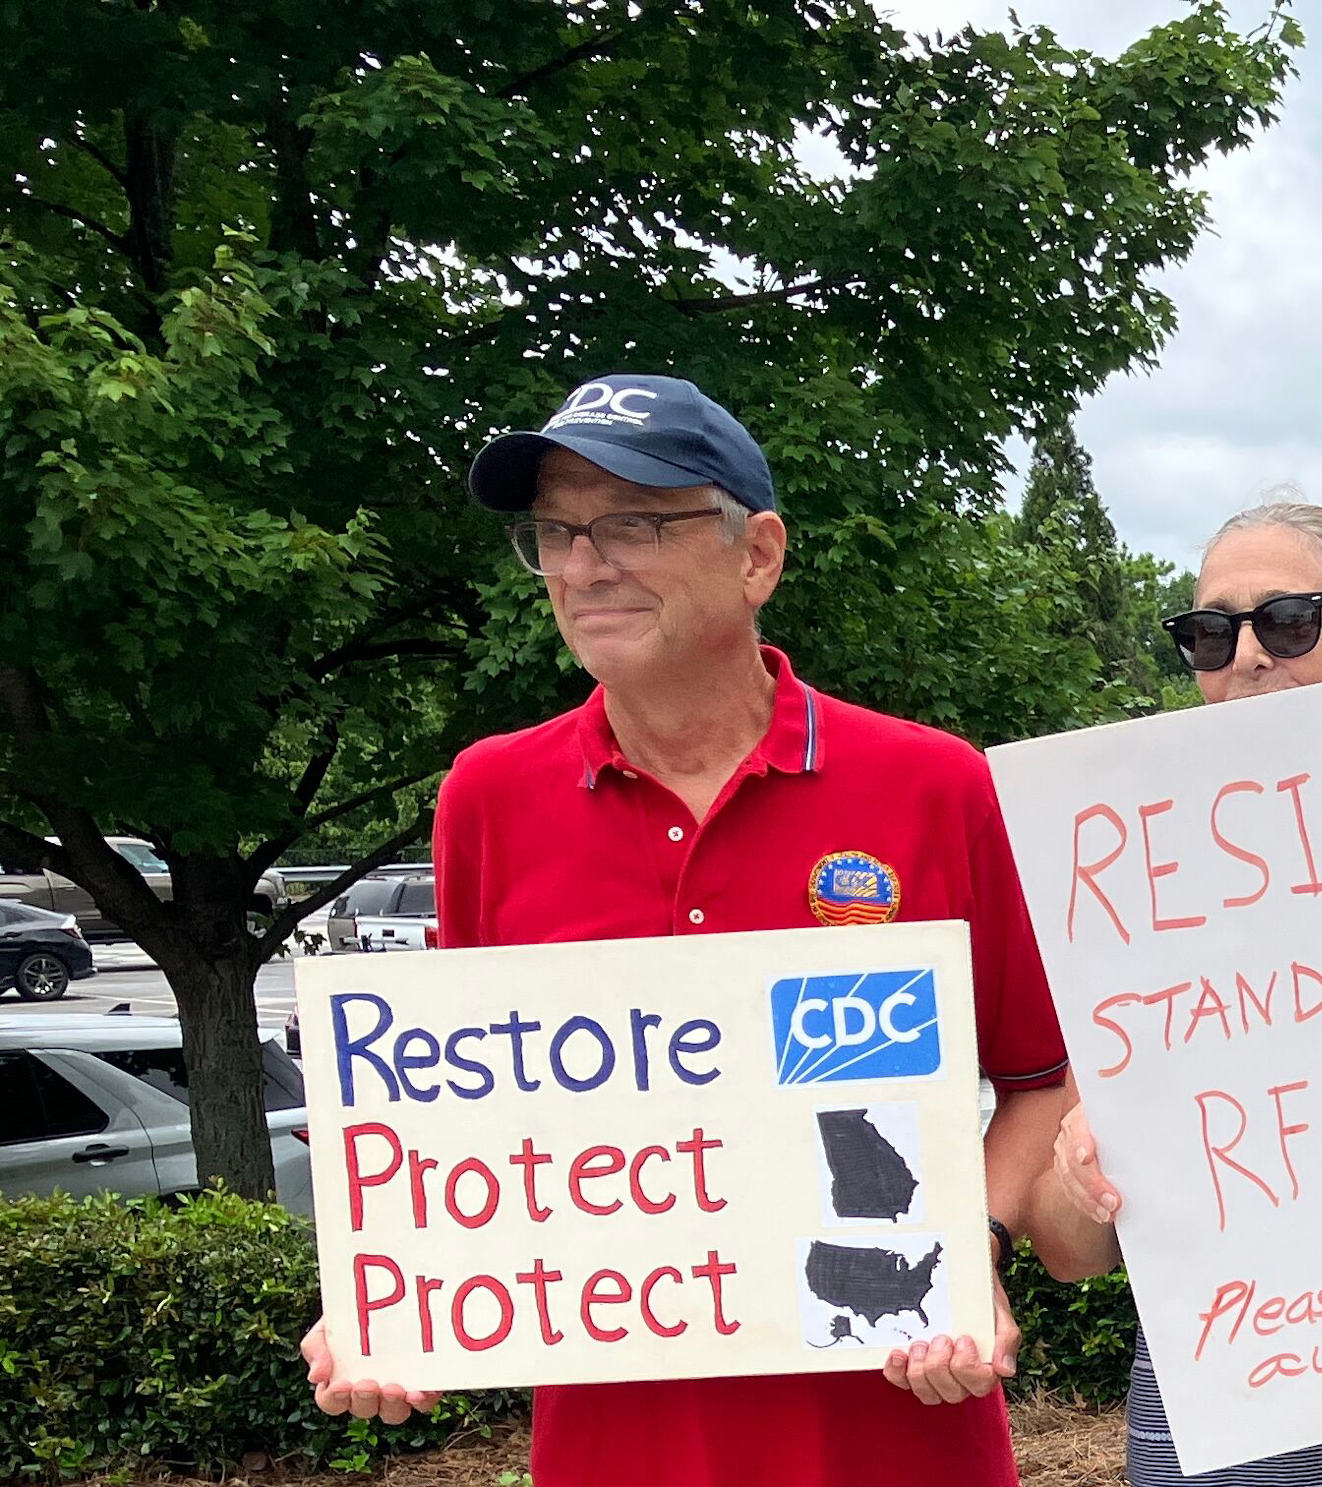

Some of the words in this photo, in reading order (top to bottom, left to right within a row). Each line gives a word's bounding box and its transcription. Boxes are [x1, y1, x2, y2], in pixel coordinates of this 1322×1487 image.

[331, 993, 721, 1106] Restore
[791, 991, 922, 1049] CDC
[344, 1123, 725, 1231] Protect
[354, 1251, 740, 1355] Protect
